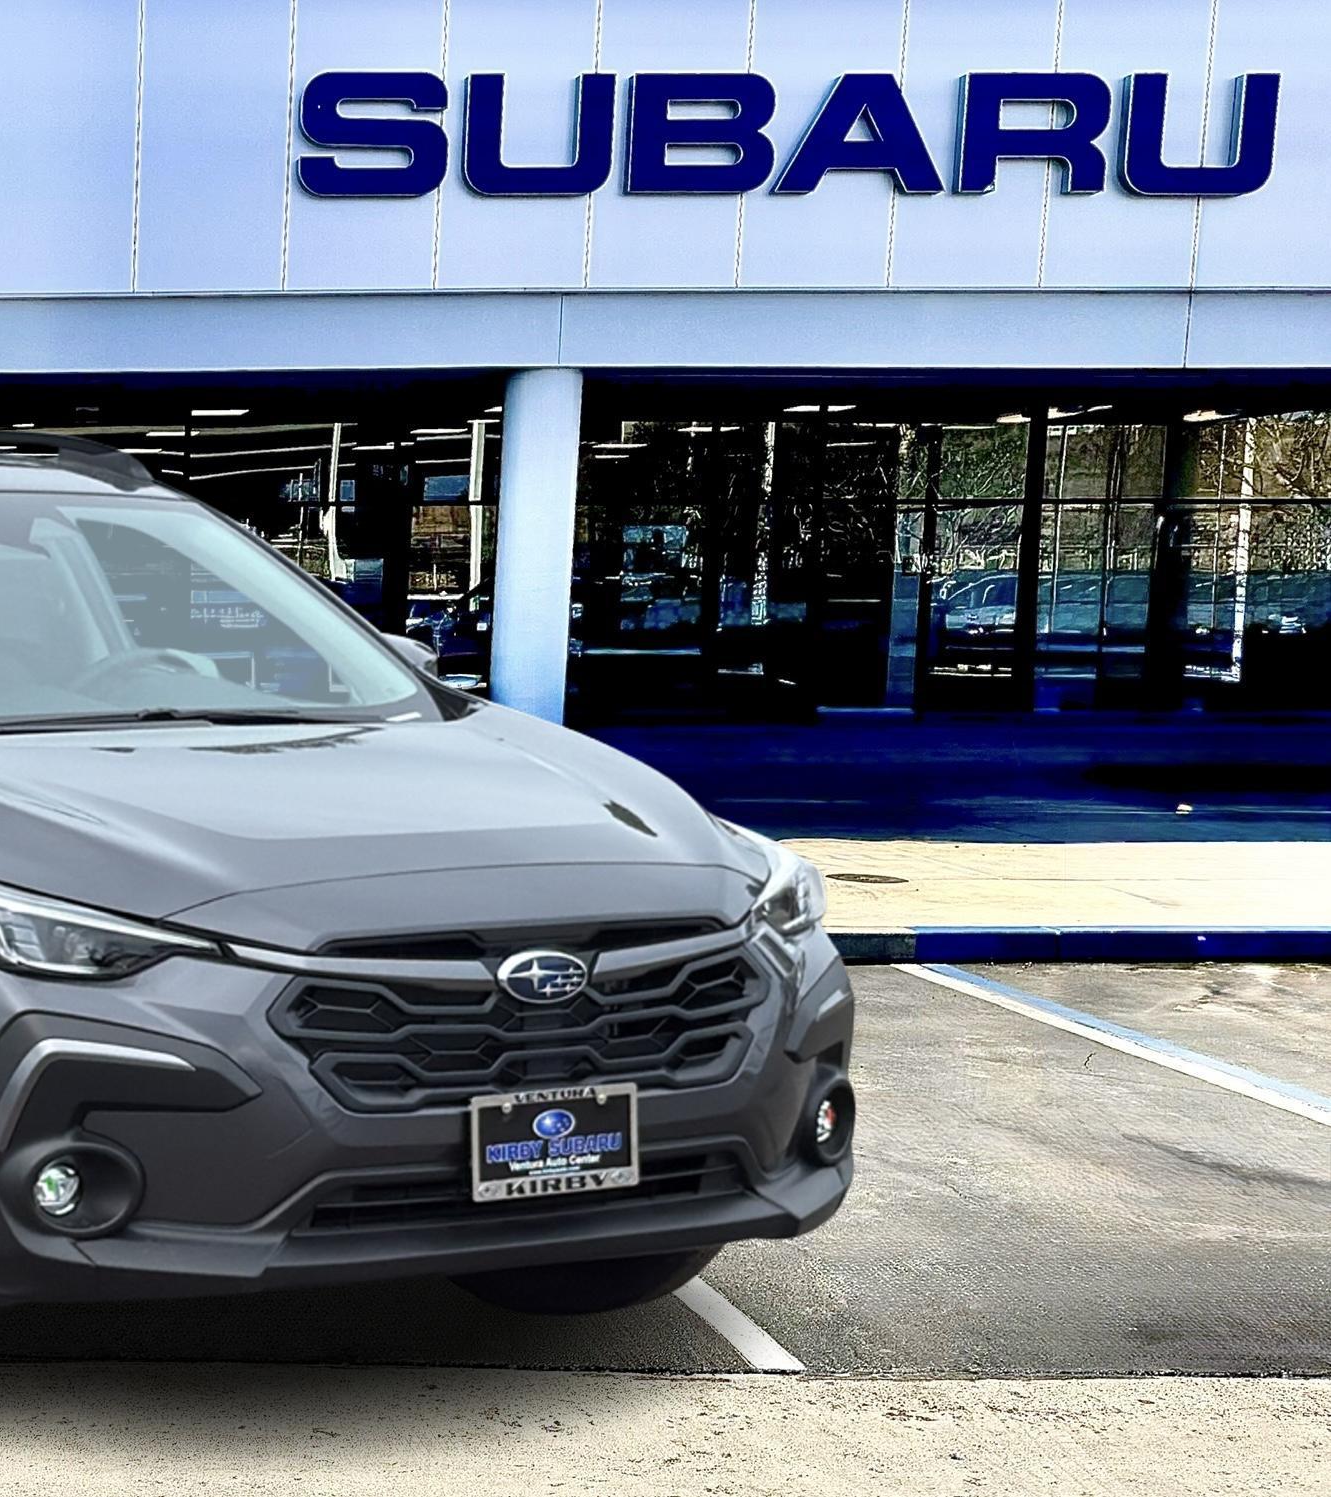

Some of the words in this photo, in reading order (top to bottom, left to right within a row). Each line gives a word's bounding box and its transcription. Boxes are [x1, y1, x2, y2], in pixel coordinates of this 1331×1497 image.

[297, 72, 1281, 197] SUBARU
[513, 1087, 596, 1104] VENTURA
[486, 1140, 544, 1164] KIRBY
[548, 1132, 623, 1157] SUBARU
[509, 1159, 544, 1172] Ventura
[545, 1156, 568, 1167] Auto
[569, 1153, 601, 1166] Center
[505, 1172, 609, 1197] KIRBY
